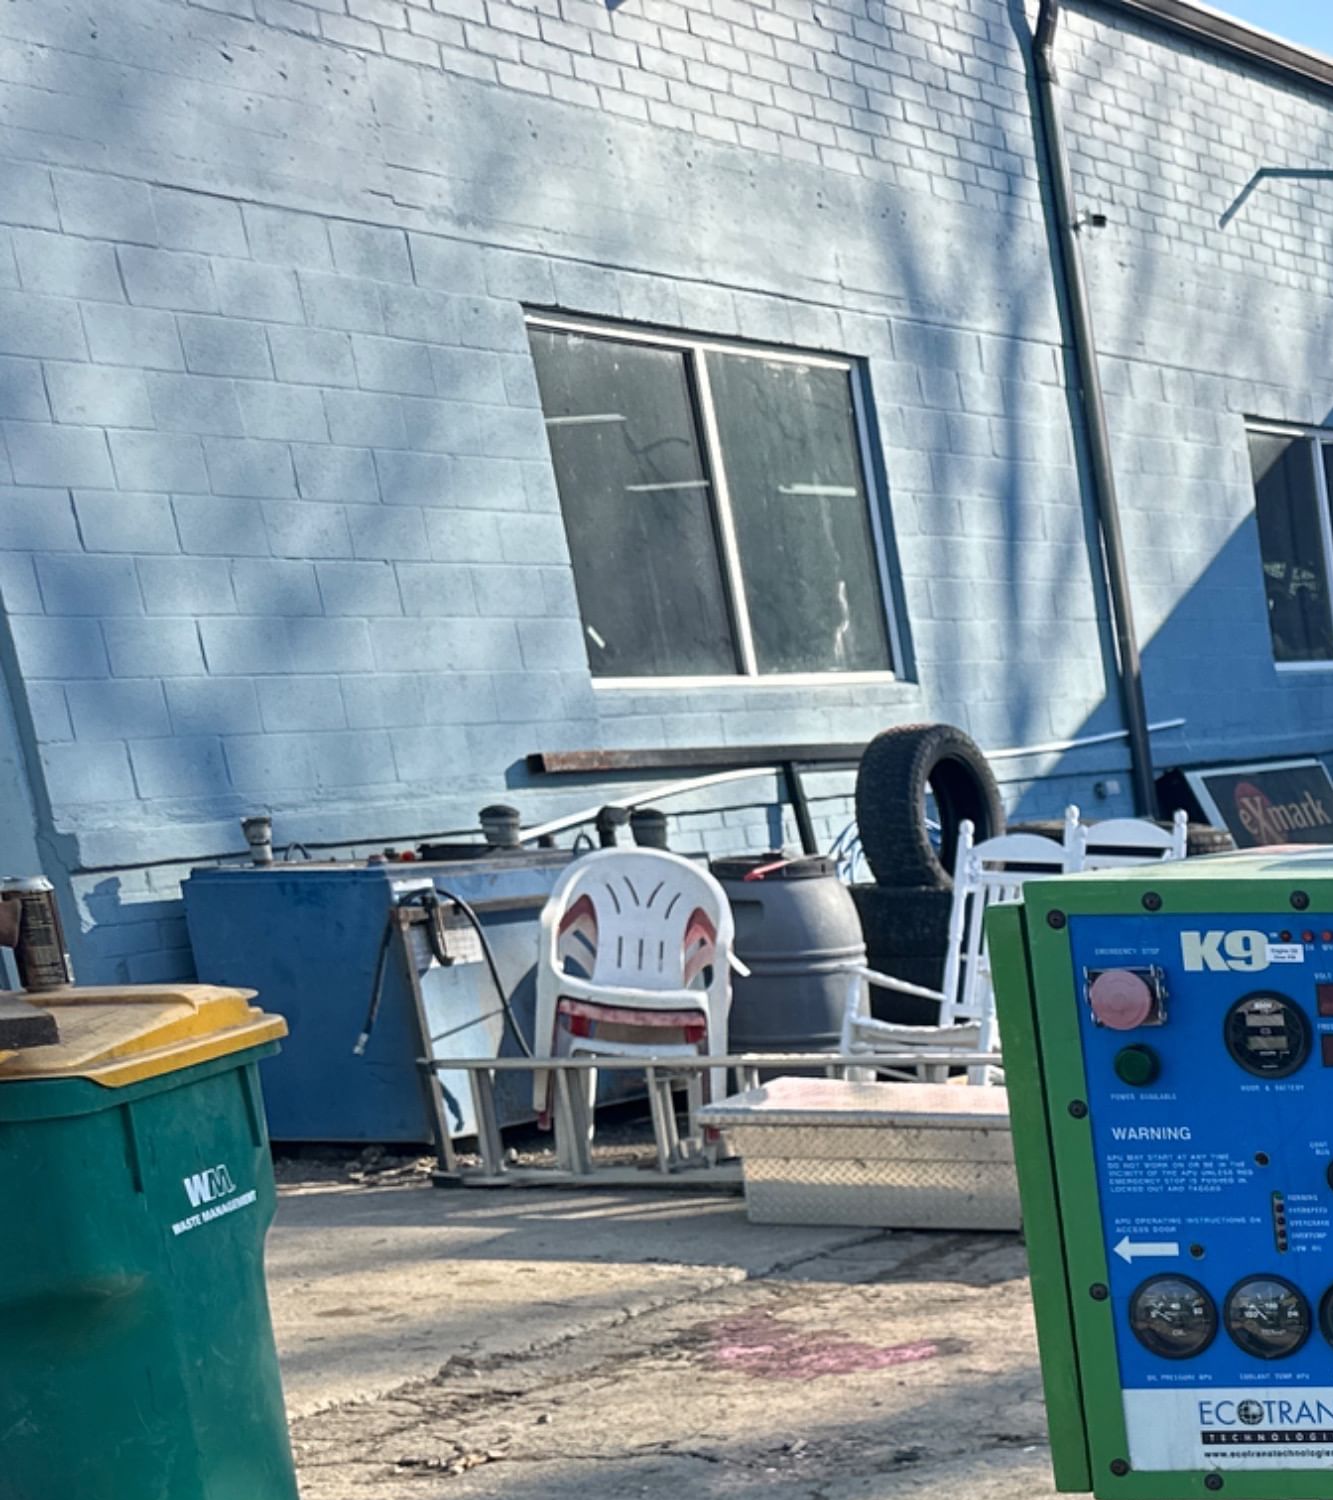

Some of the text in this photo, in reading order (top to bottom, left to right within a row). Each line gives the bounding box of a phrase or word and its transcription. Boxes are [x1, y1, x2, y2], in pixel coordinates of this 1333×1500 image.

[1180, 930, 1270, 973] K9
[1111, 1126, 1192, 1140] WARNING
[183, 1164, 237, 1207] WM
[171, 1189, 257, 1236] WASTE MANAGEMENT
